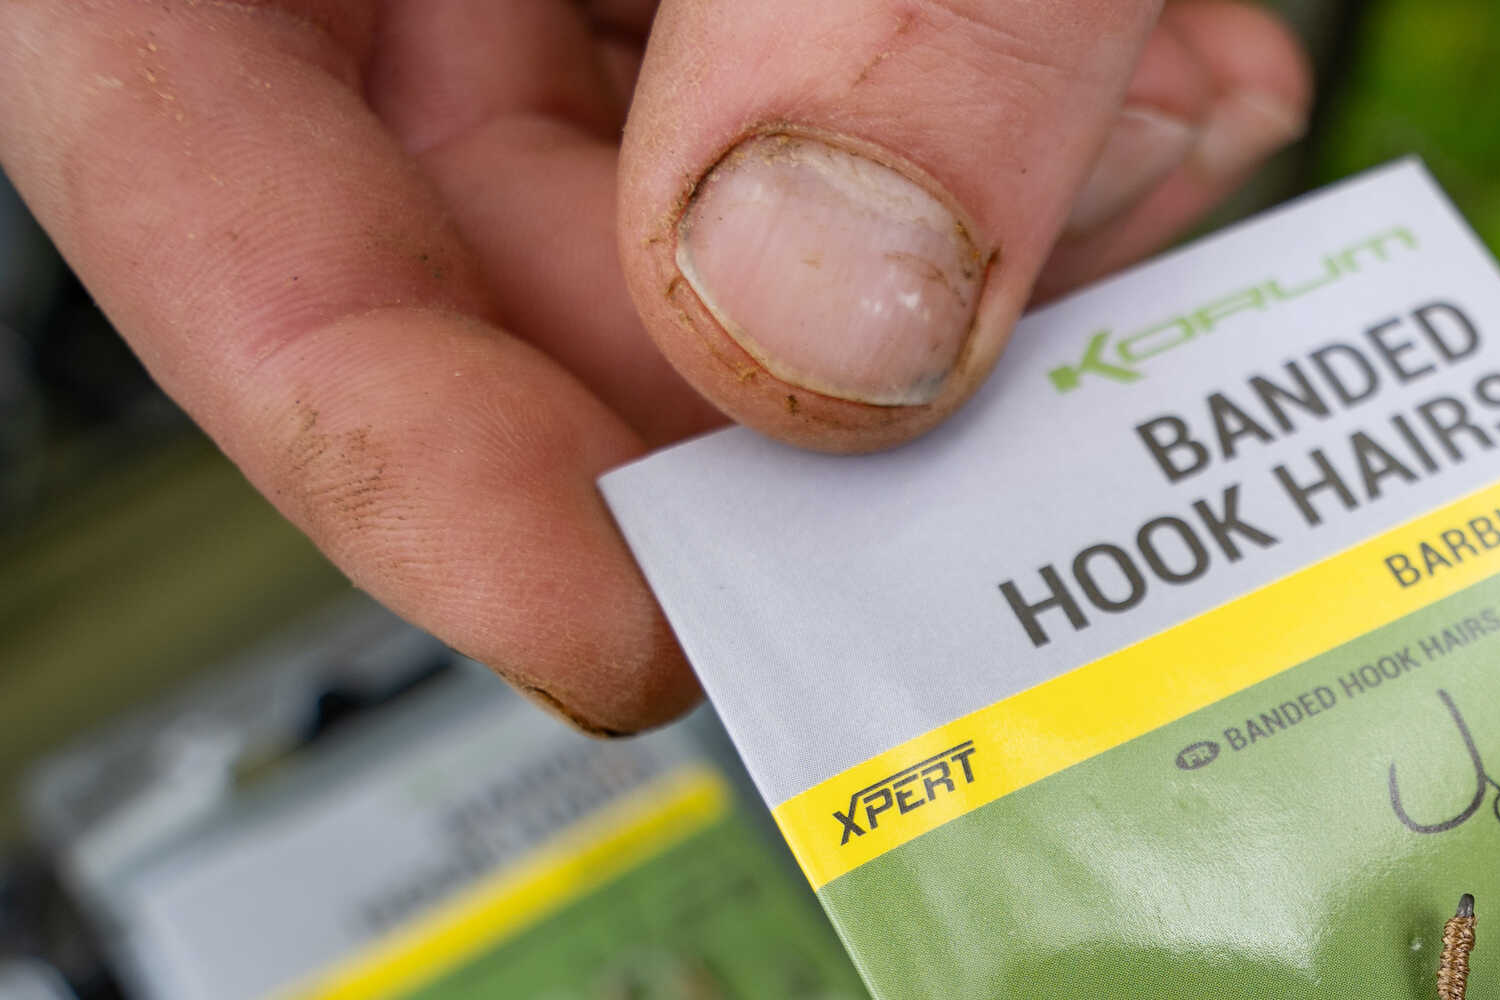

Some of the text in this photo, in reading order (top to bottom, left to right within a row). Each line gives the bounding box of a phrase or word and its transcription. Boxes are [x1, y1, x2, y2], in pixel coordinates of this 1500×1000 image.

[1047, 226, 1418, 393] KORUM
[1134, 299, 1482, 486] BANDED
[999, 484, 1280, 648] HOOK
[1223, 686, 1337, 751] BANDED
[1337, 648, 1421, 698] HOOK
[832, 740, 976, 846] XPERT
